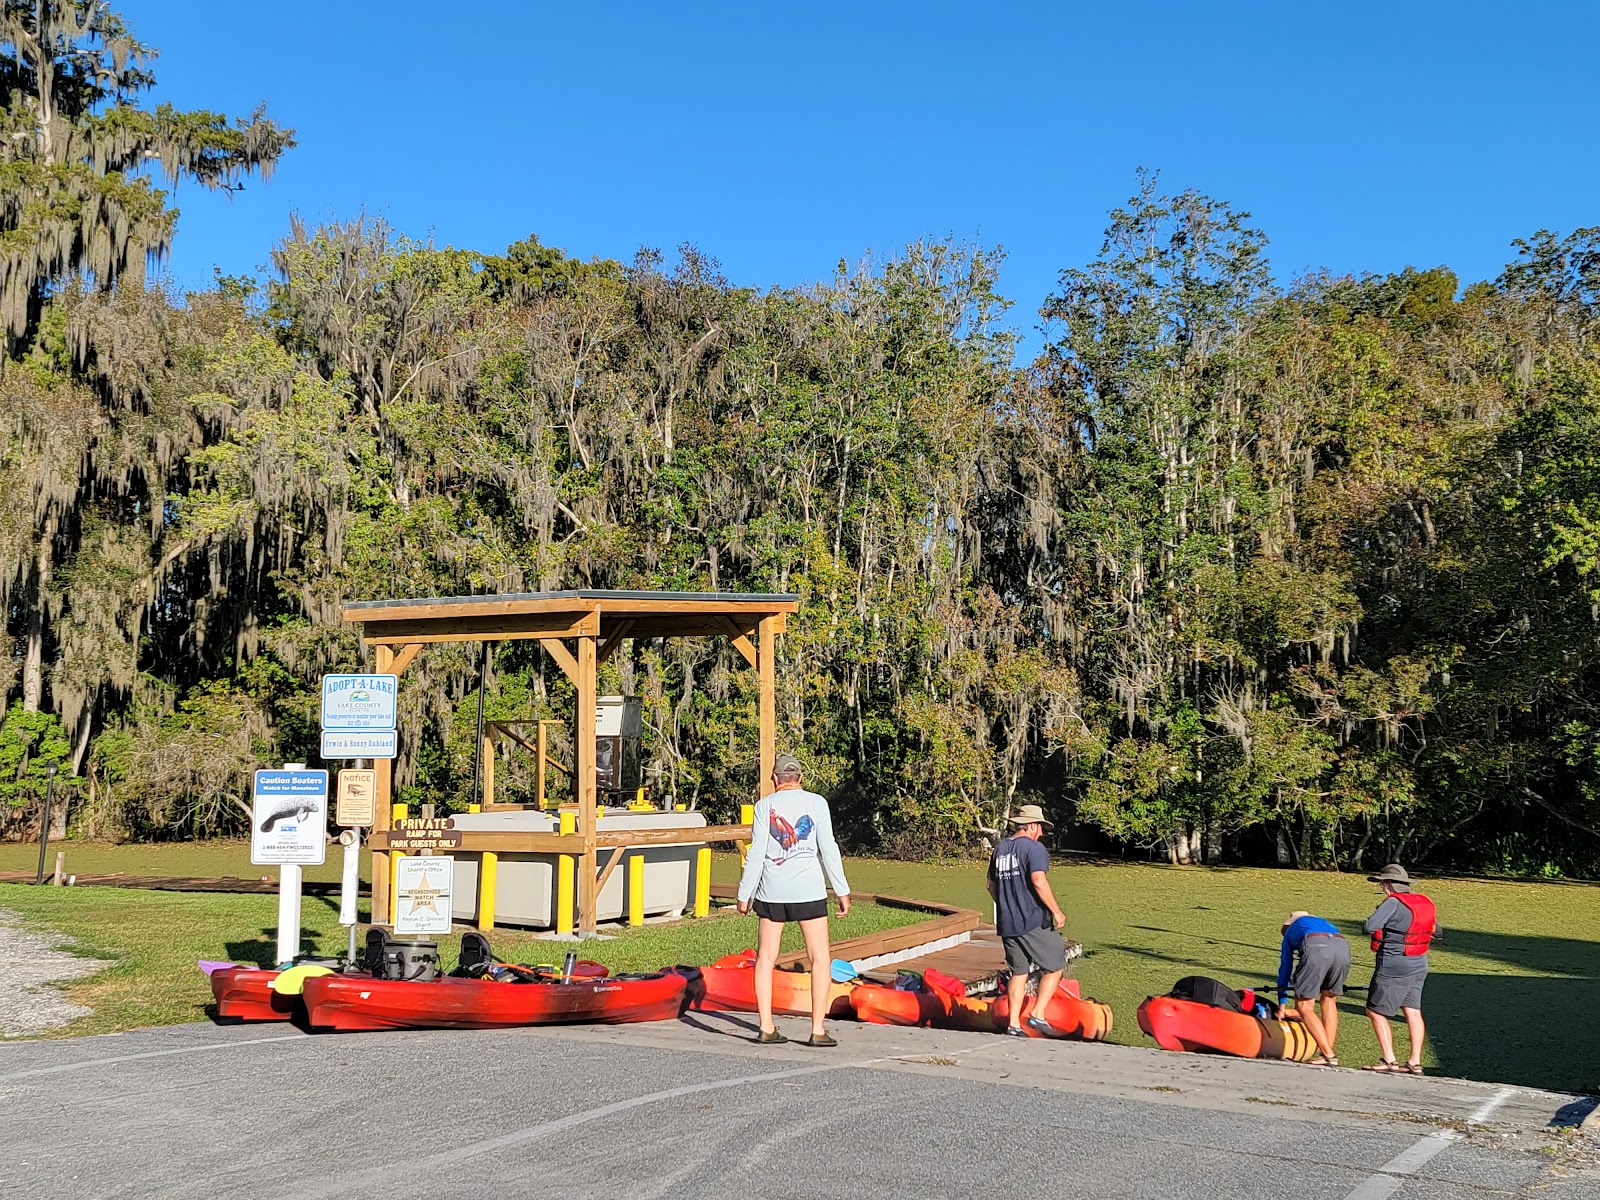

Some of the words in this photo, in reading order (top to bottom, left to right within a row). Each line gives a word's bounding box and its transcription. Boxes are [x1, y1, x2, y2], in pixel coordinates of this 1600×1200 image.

[327, 679, 392, 694] ADOPT-A-LAKE
[401, 819, 448, 830] PRIVATE
[390, 840, 408, 848] PARK
[410, 840, 436, 848] GUESTS
[438, 840, 456, 848] ONLY
